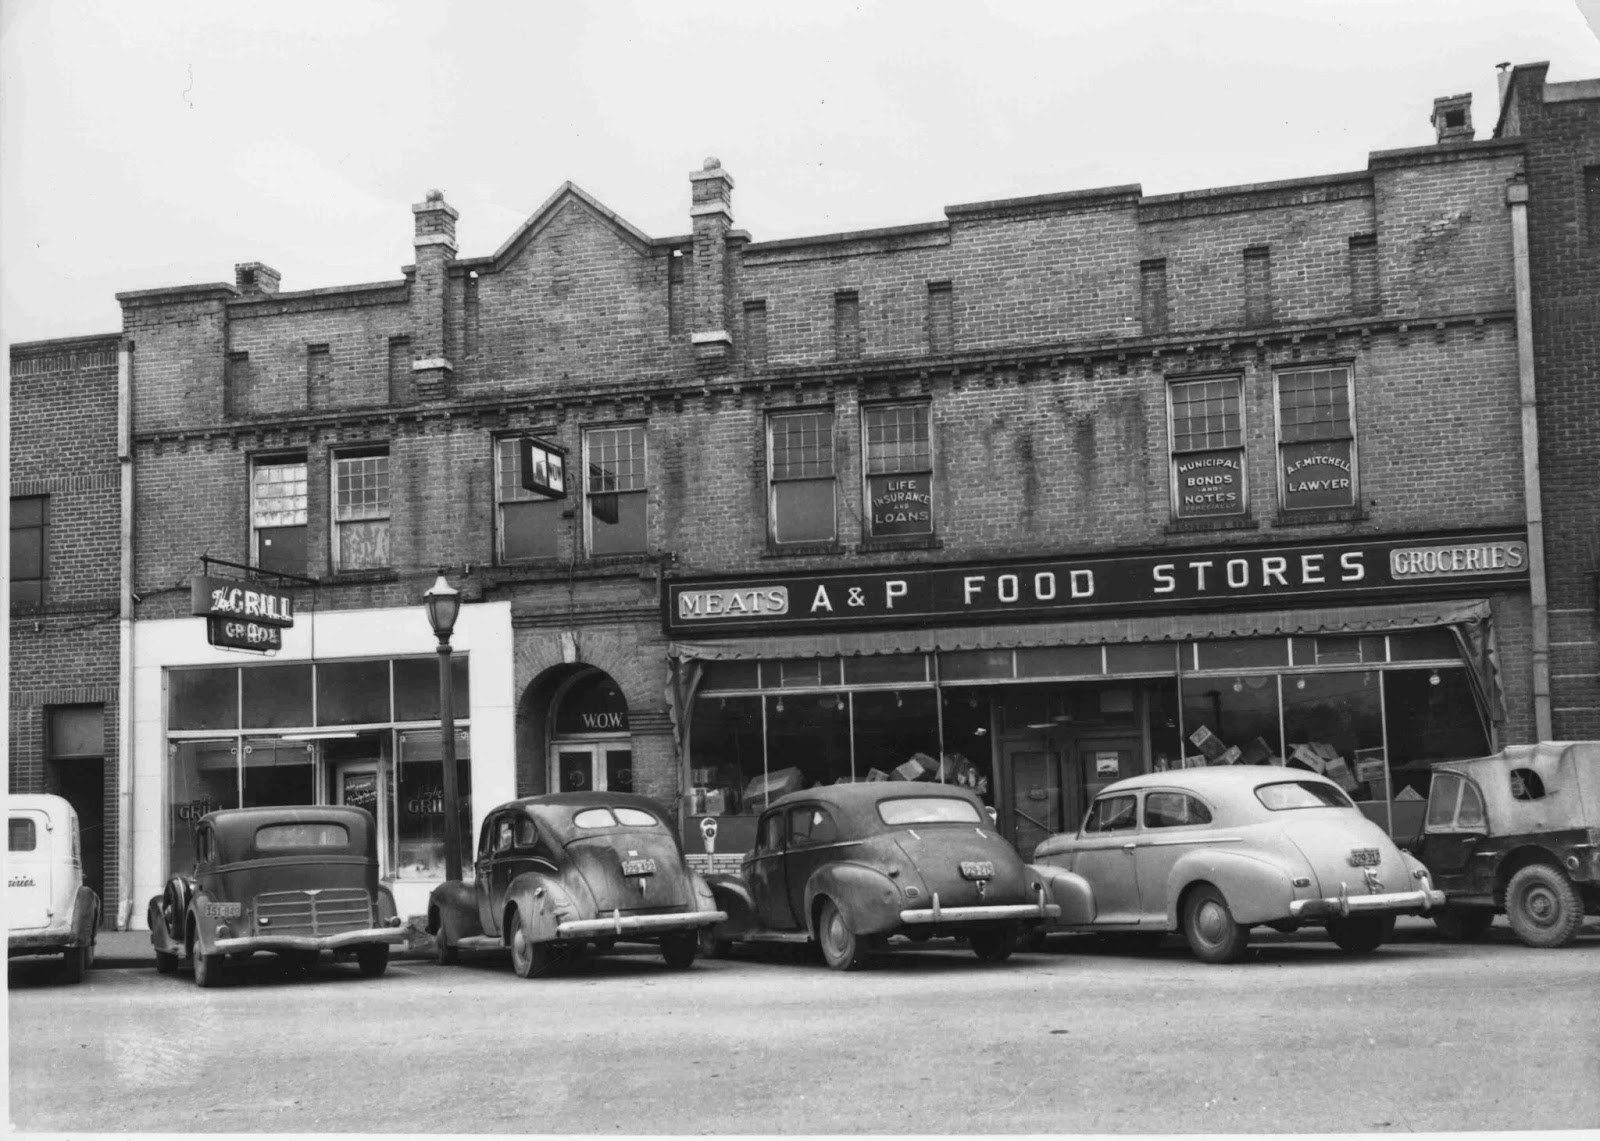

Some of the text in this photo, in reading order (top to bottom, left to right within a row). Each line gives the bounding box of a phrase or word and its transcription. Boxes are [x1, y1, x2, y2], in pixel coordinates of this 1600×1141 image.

[1179, 458, 1240, 473] MUNICIPAL
[888, 480, 917, 491] LIFE
[1187, 474, 1233, 487] BONDS
[1288, 478, 1350, 492] LAWYER
[873, 492, 931, 508] INSURANCE
[1185, 492, 1236, 504] NOTES
[875, 511, 929, 524] LOANS
[1394, 546, 1523, 574] GROCERIES
[810, 552, 1365, 612] A & P FOOD STORES
[229, 588, 294, 621] GRILL
[681, 591, 785, 617] MEATS
[408, 799, 447, 814] GRIL
